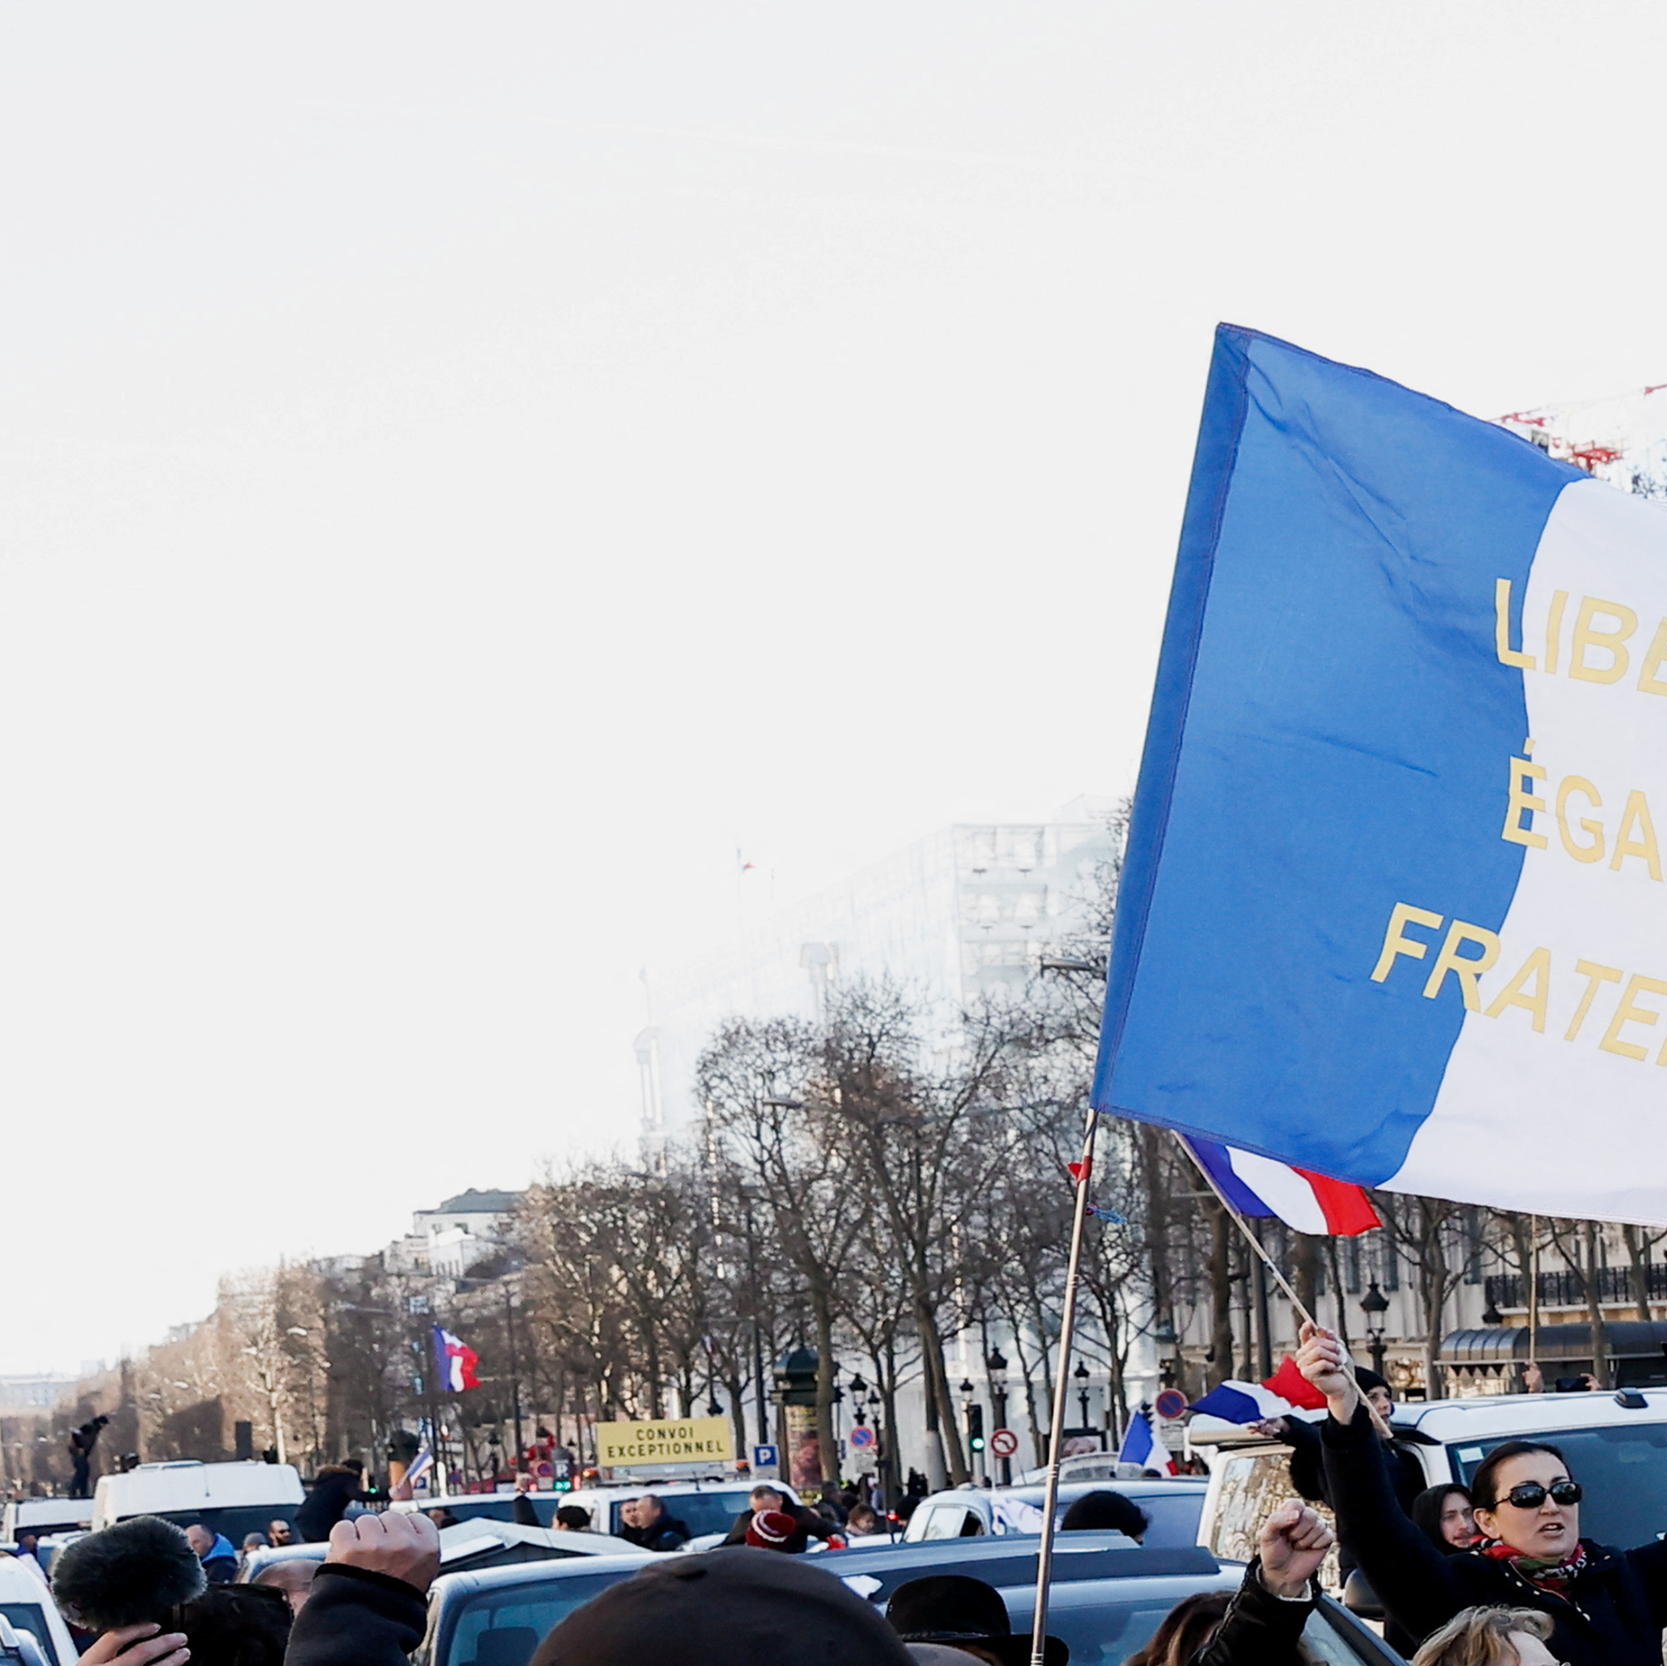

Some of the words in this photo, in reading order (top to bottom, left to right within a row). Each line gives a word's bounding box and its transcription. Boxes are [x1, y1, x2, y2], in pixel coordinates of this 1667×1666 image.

[636, 1427, 694, 1441] CONVOI
[608, 1440, 724, 1458] EXCEPTIONNEL
[759, 1449, 771, 1463] P
